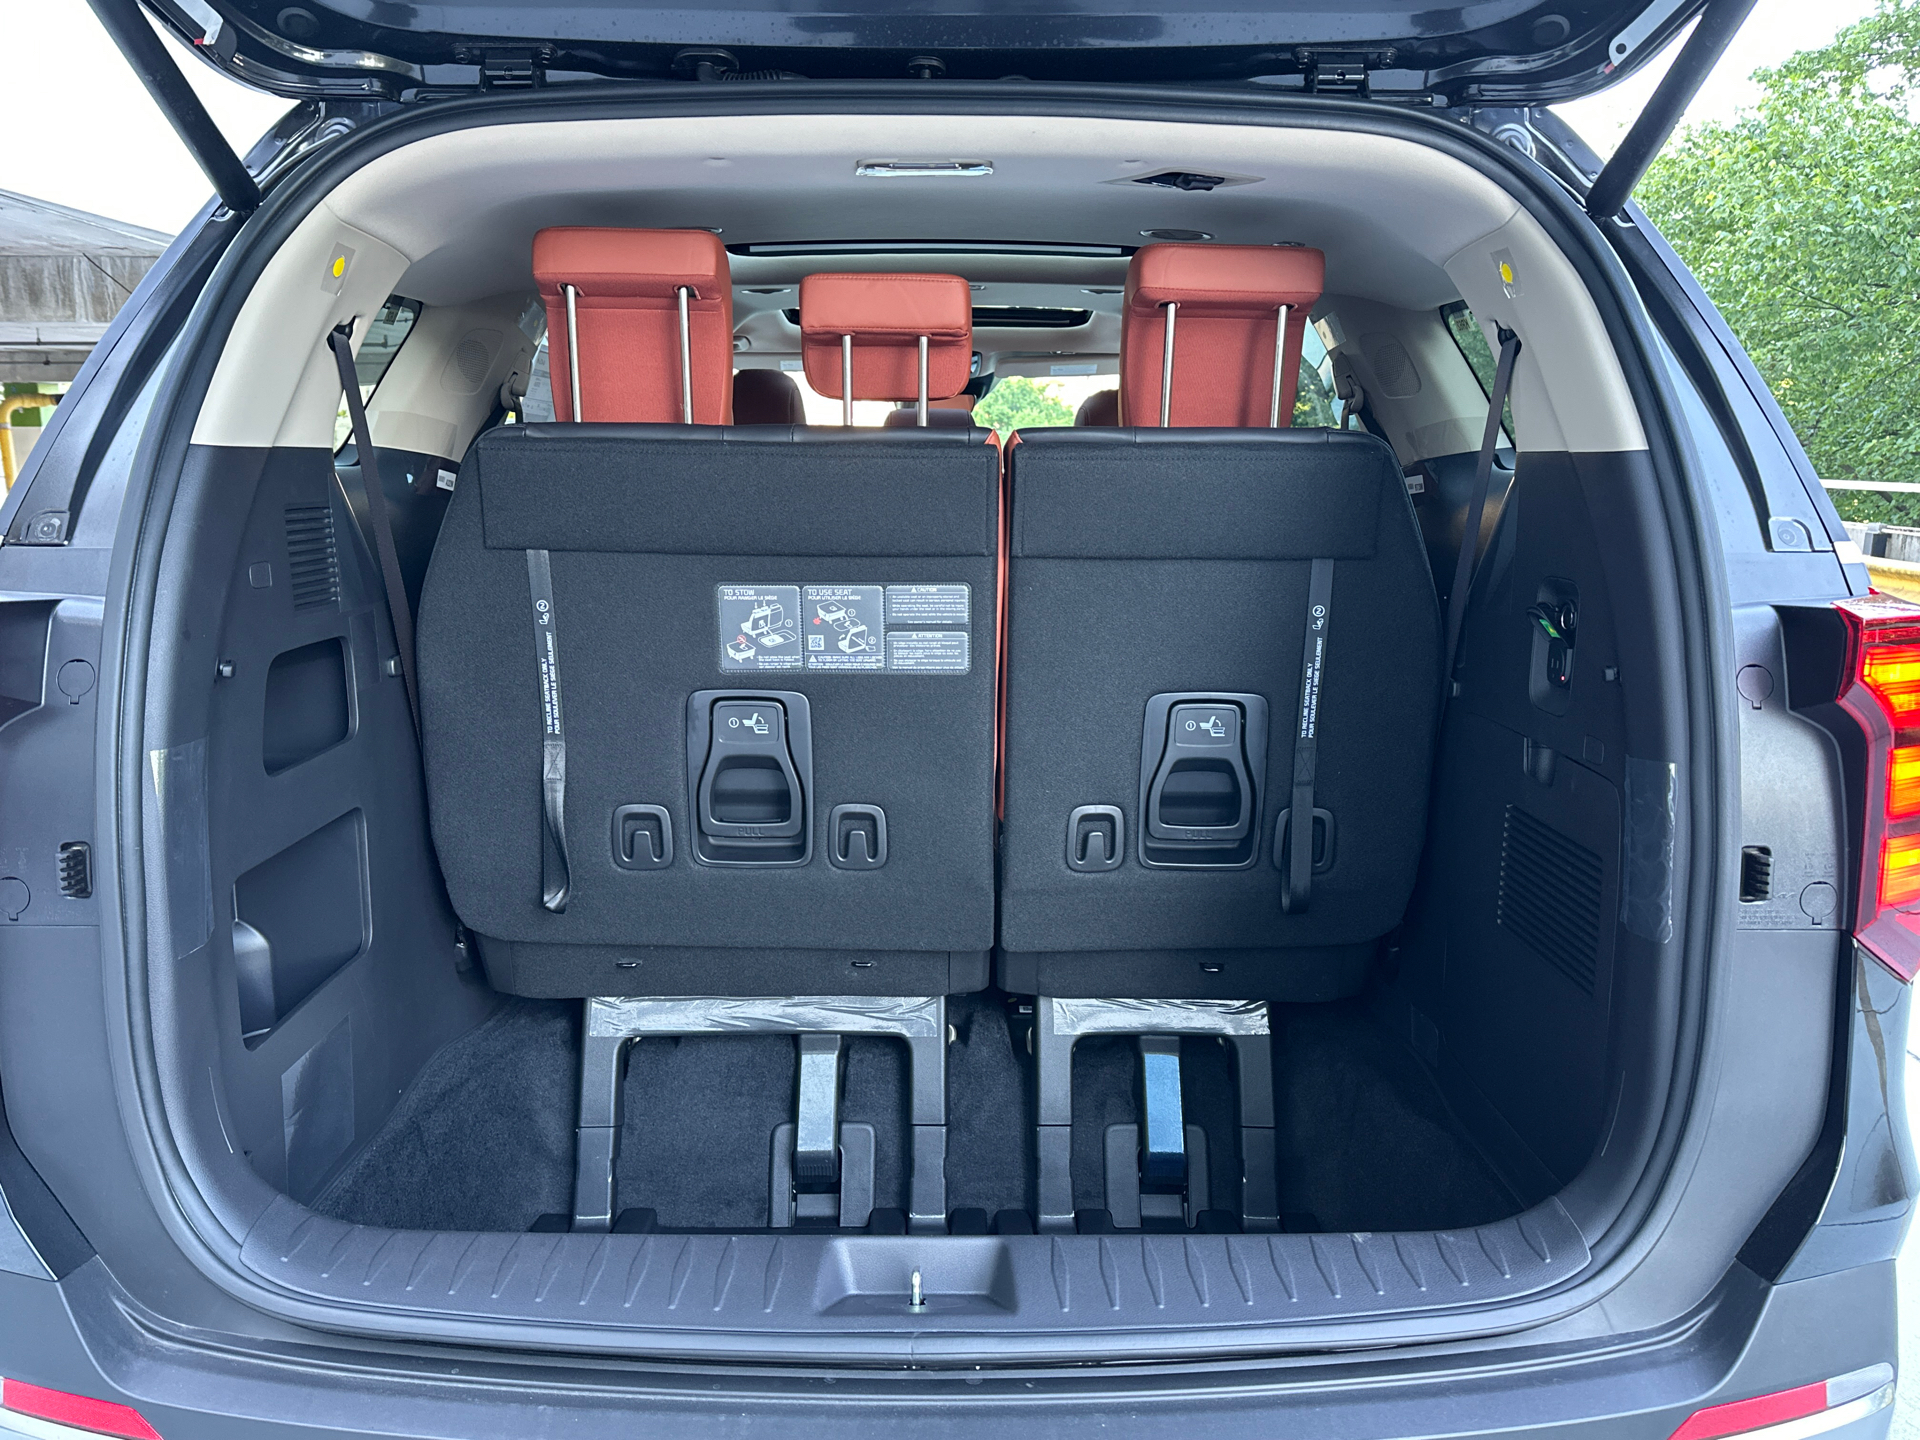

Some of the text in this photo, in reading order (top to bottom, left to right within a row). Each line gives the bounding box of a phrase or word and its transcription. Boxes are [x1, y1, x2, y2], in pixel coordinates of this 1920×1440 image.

[546, 631, 555, 664] SEULEMENT
[1315, 636, 1323, 669] SEULEMENT
[543, 673, 551, 702] SEATBACK
[550, 681, 557, 690] LE
[1304, 678, 1312, 707] SEATBACK
[1312, 686, 1319, 694] LE
[551, 690, 560, 718] SOULEVER
[1310, 694, 1318, 722] SOULEVER
[547, 725, 553, 734] TO
[1302, 707, 1310, 730] RECLINE
[1300, 730, 1307, 739] TO
[737, 827, 765, 836] PULL
[1184, 830, 1213, 839] PULL
